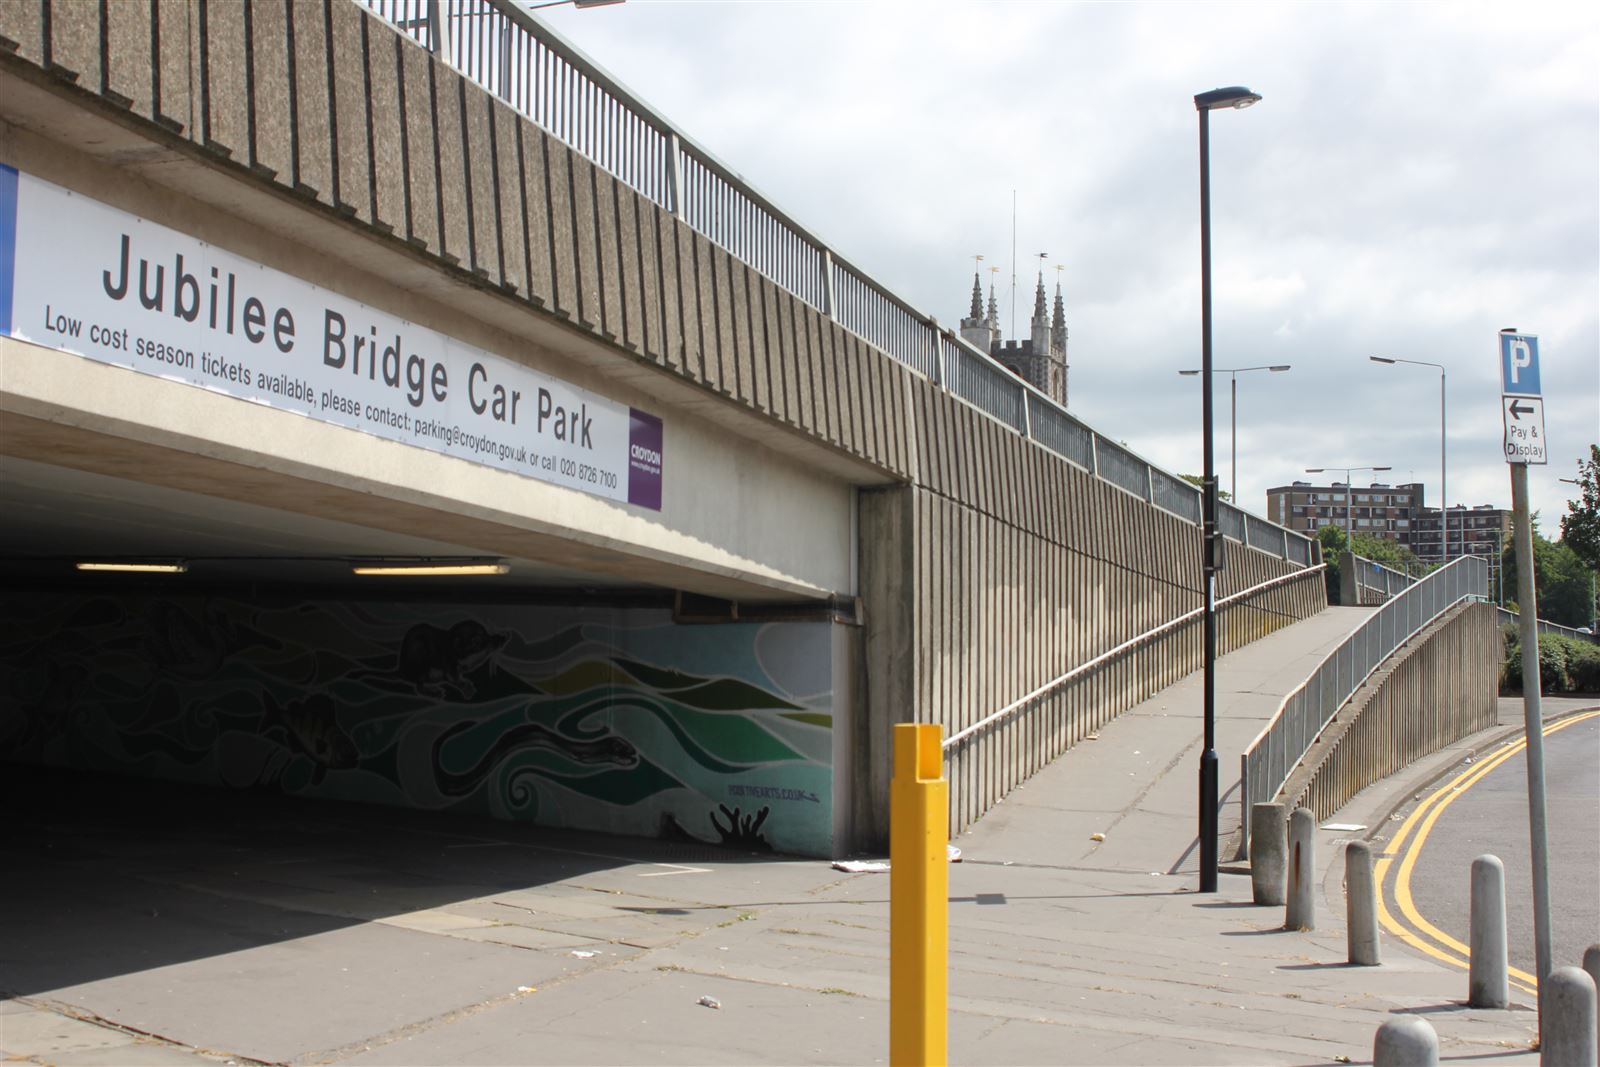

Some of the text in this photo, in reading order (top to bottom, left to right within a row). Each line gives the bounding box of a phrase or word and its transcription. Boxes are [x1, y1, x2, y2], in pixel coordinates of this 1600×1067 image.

[103, 233, 593, 450] Jubilee Bridge Car Park
[1509, 339, 1531, 383] P
[45, 304, 617, 489] Low cost season tickets available, please contact: parking@croydon.gov.uk or call 020 8726 7100
[1510, 425, 1538, 439] Pay &
[631, 444, 660, 465] CROYDON
[1507, 443, 1543, 458] Display
